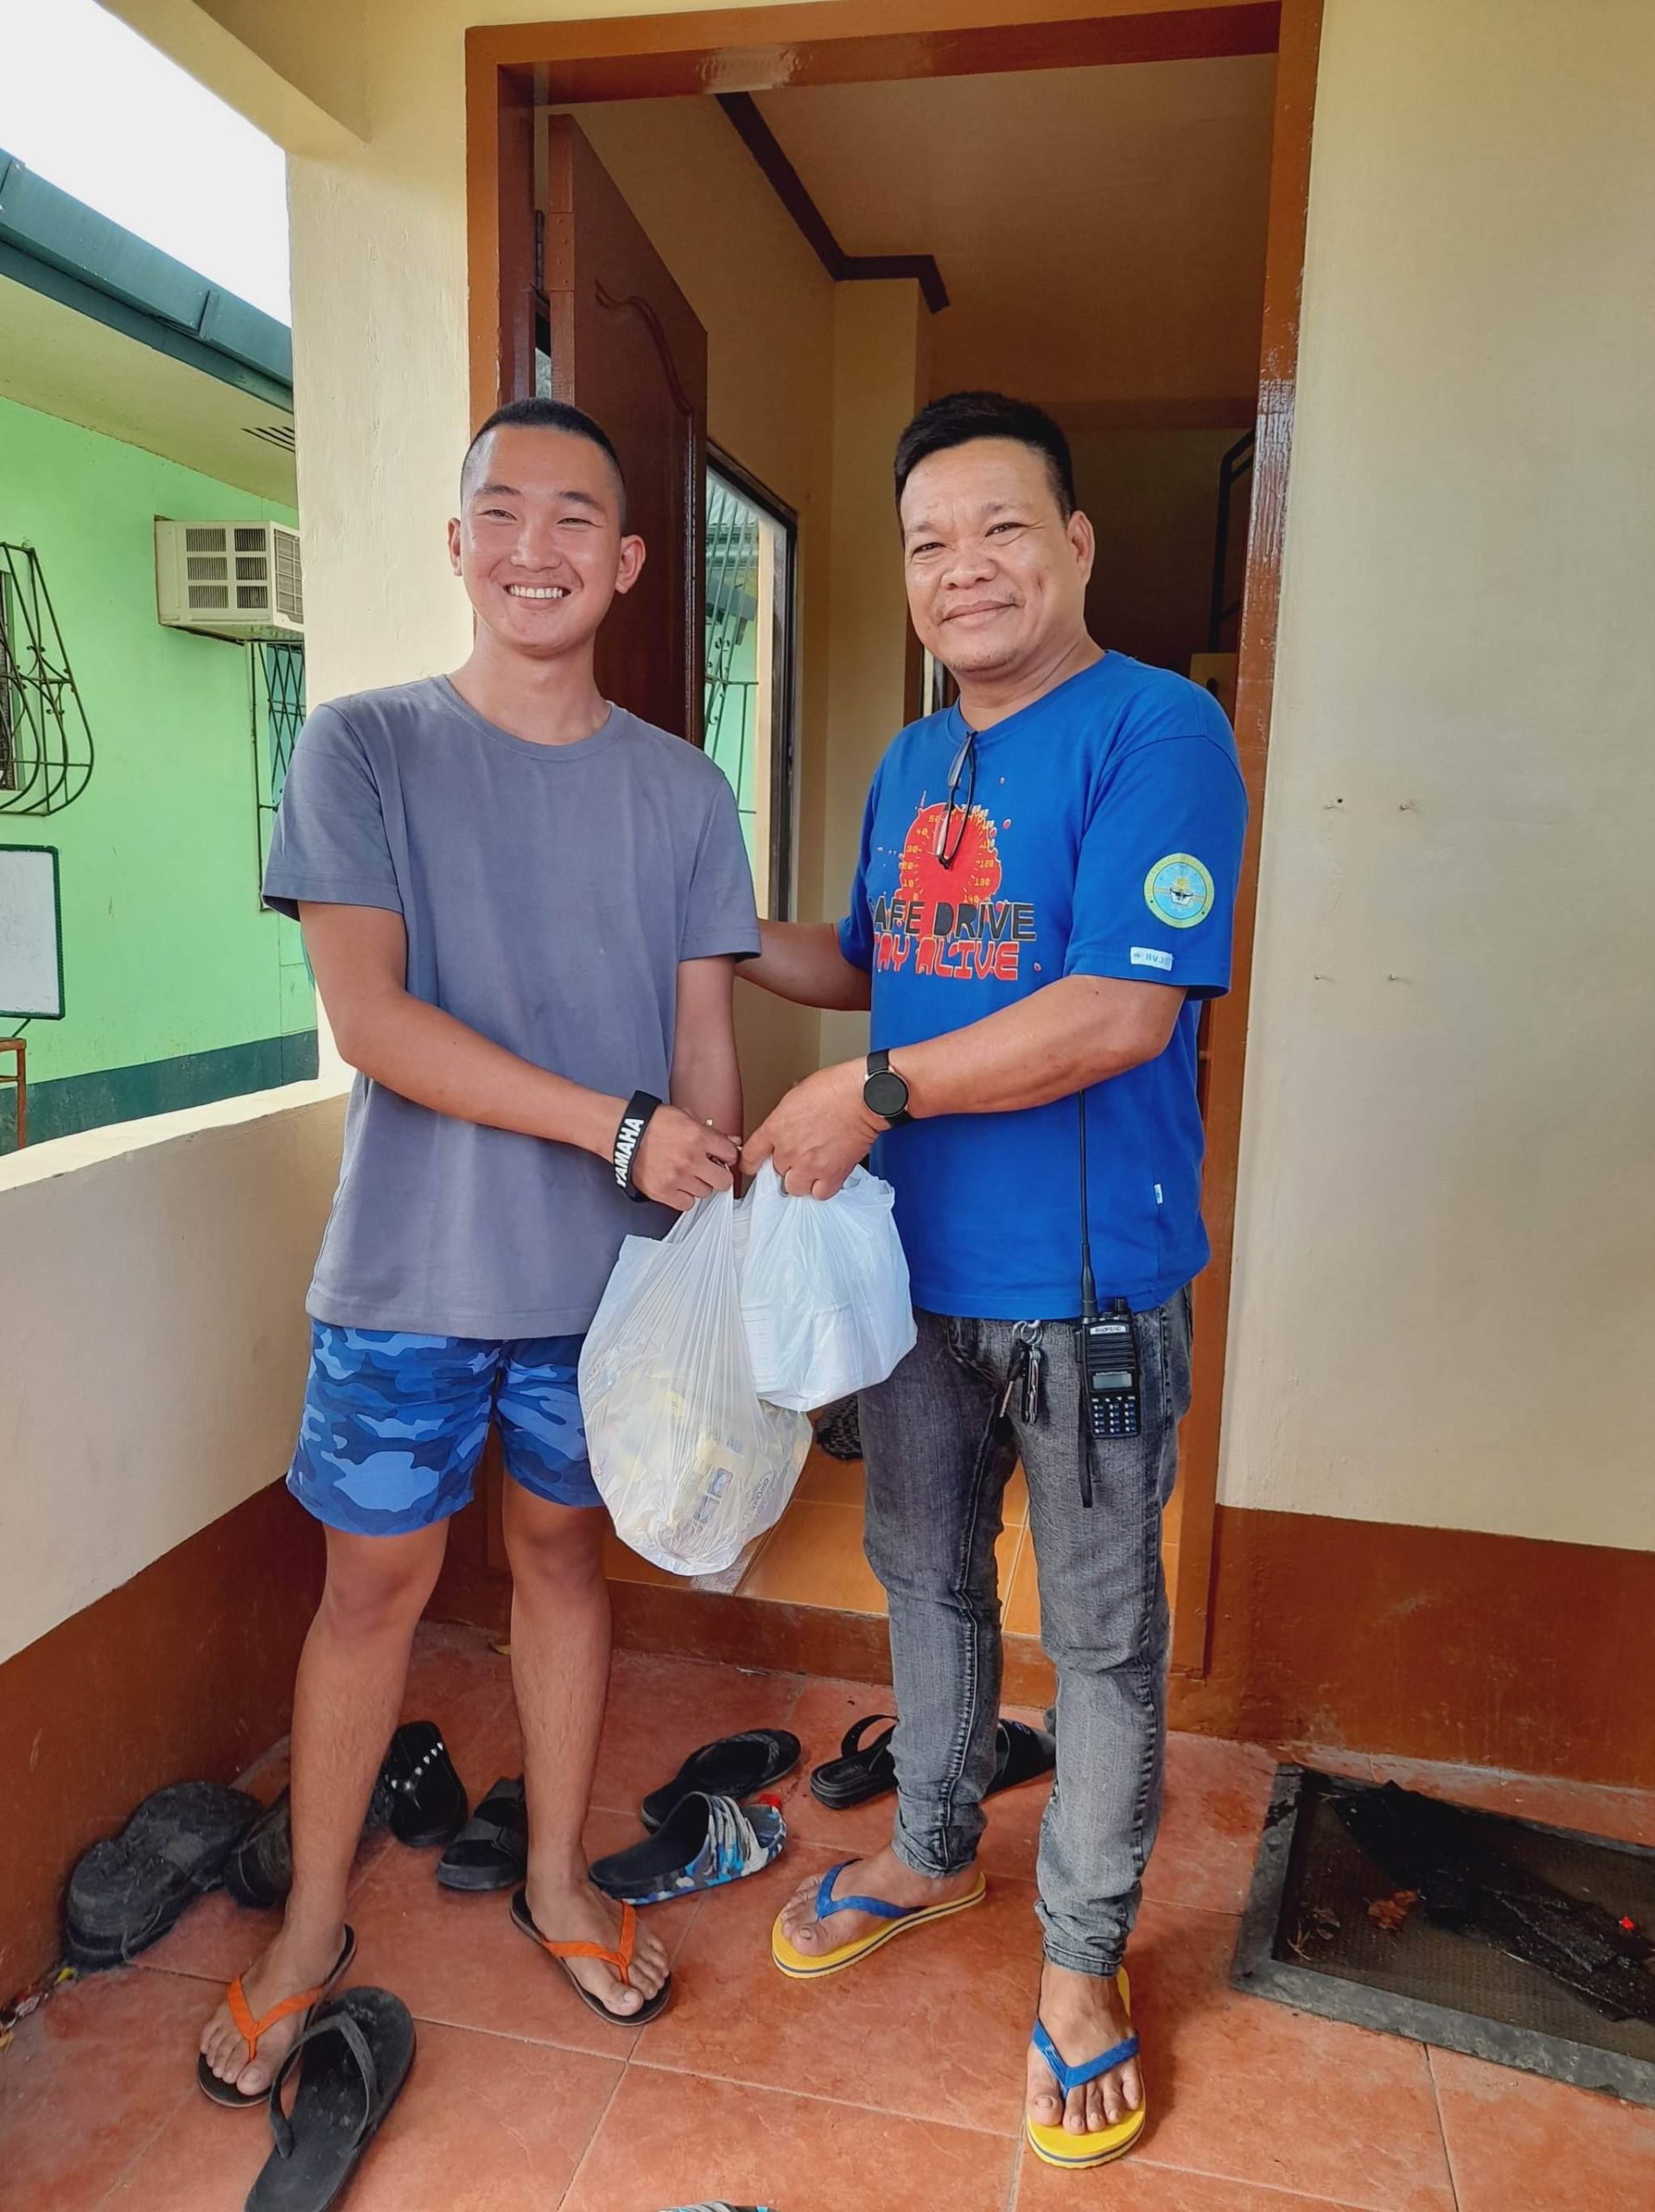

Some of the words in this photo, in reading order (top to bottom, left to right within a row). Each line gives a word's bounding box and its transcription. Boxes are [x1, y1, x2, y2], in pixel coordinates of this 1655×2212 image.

[979, 859, 994, 868] 120
[902, 878, 913, 888] 10
[974, 877, 990, 887] 130
[868, 895, 926, 937] AFE
[933, 900, 1036, 942] DRIVE
[915, 935, 1021, 981] ALIVE
[614, 1117, 646, 1188] YAMAHA
